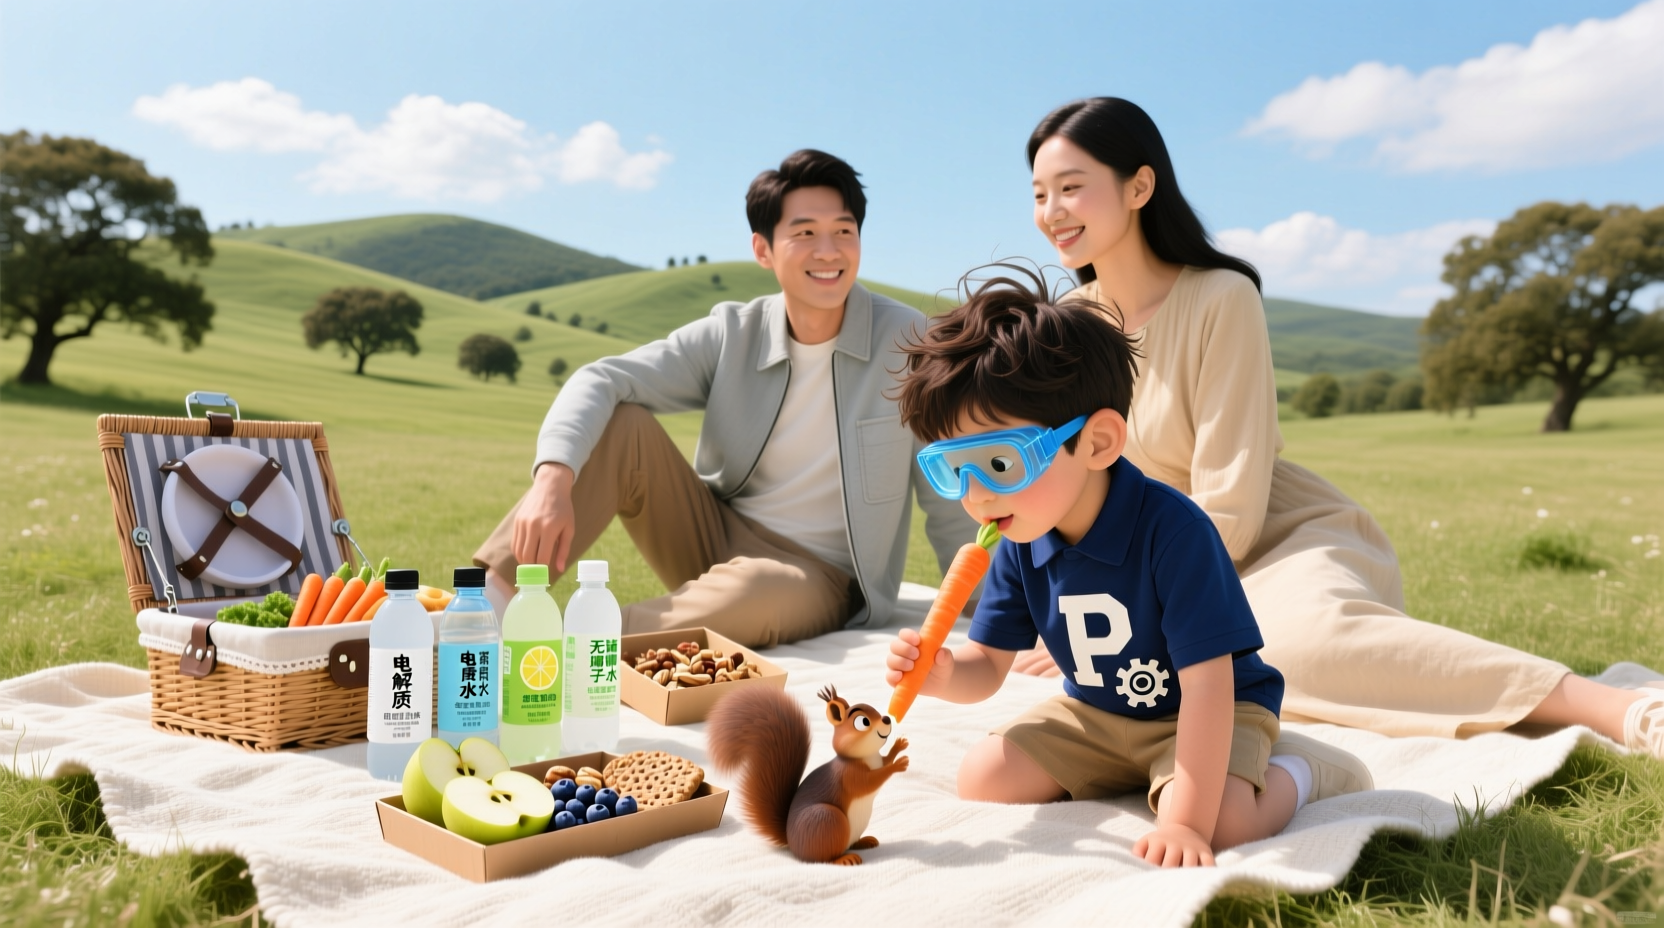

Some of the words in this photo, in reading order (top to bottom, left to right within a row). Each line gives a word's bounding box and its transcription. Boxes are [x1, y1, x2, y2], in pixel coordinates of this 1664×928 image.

[1058, 593, 1133, 687] P
[392, 653, 413, 710] 电解质
